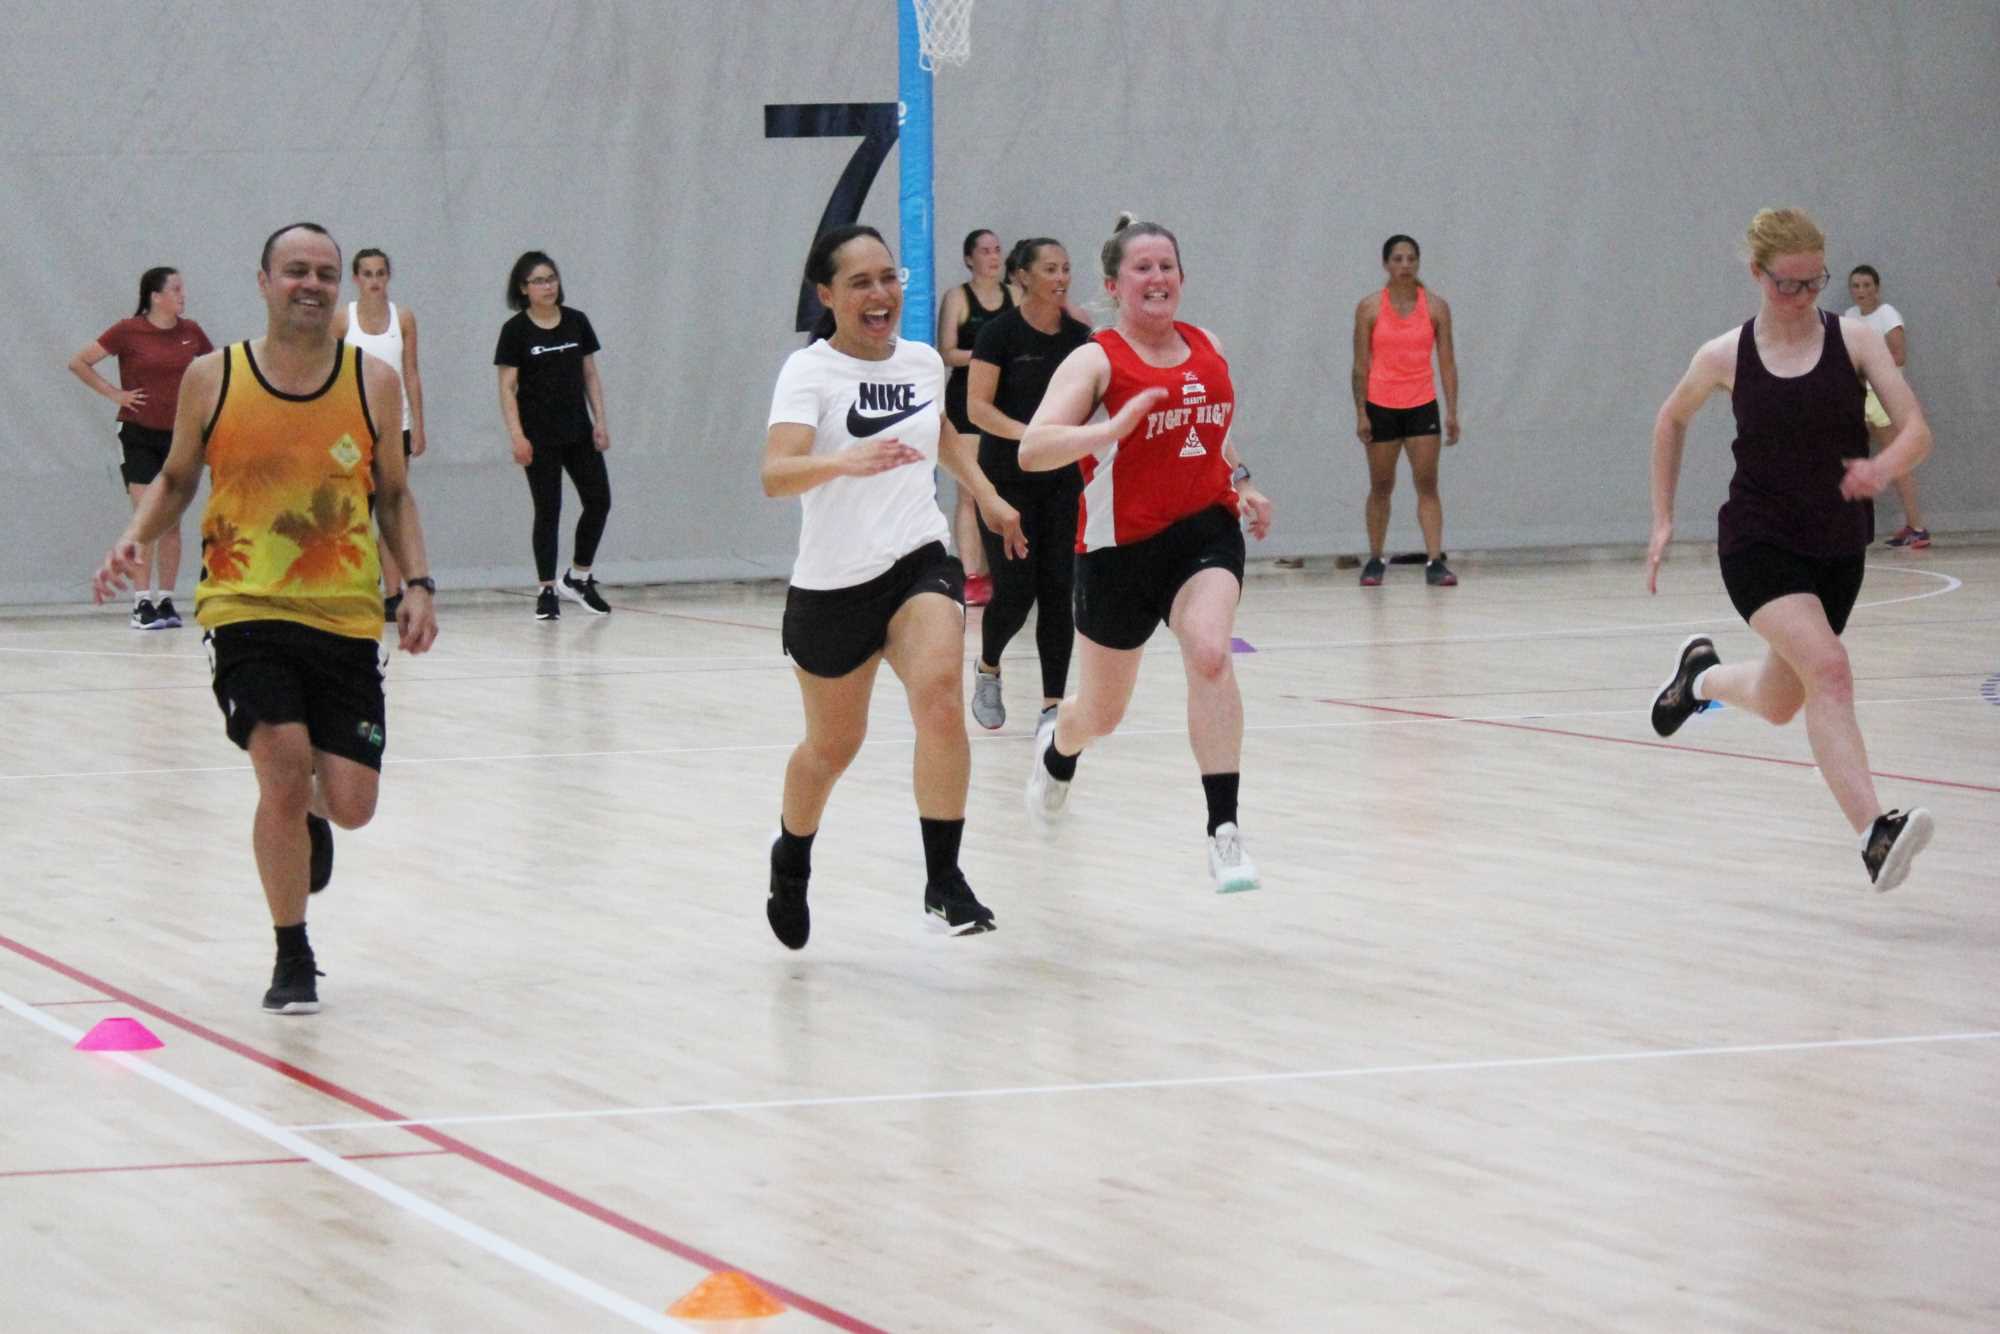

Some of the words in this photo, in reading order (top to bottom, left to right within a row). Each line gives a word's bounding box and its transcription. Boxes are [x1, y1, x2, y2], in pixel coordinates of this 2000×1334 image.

[764, 103, 899, 332] 7
[859, 382, 916, 411] NIKE
[1145, 408, 1192, 439] FIGHT
[1196, 402, 1232, 427] NIGH
